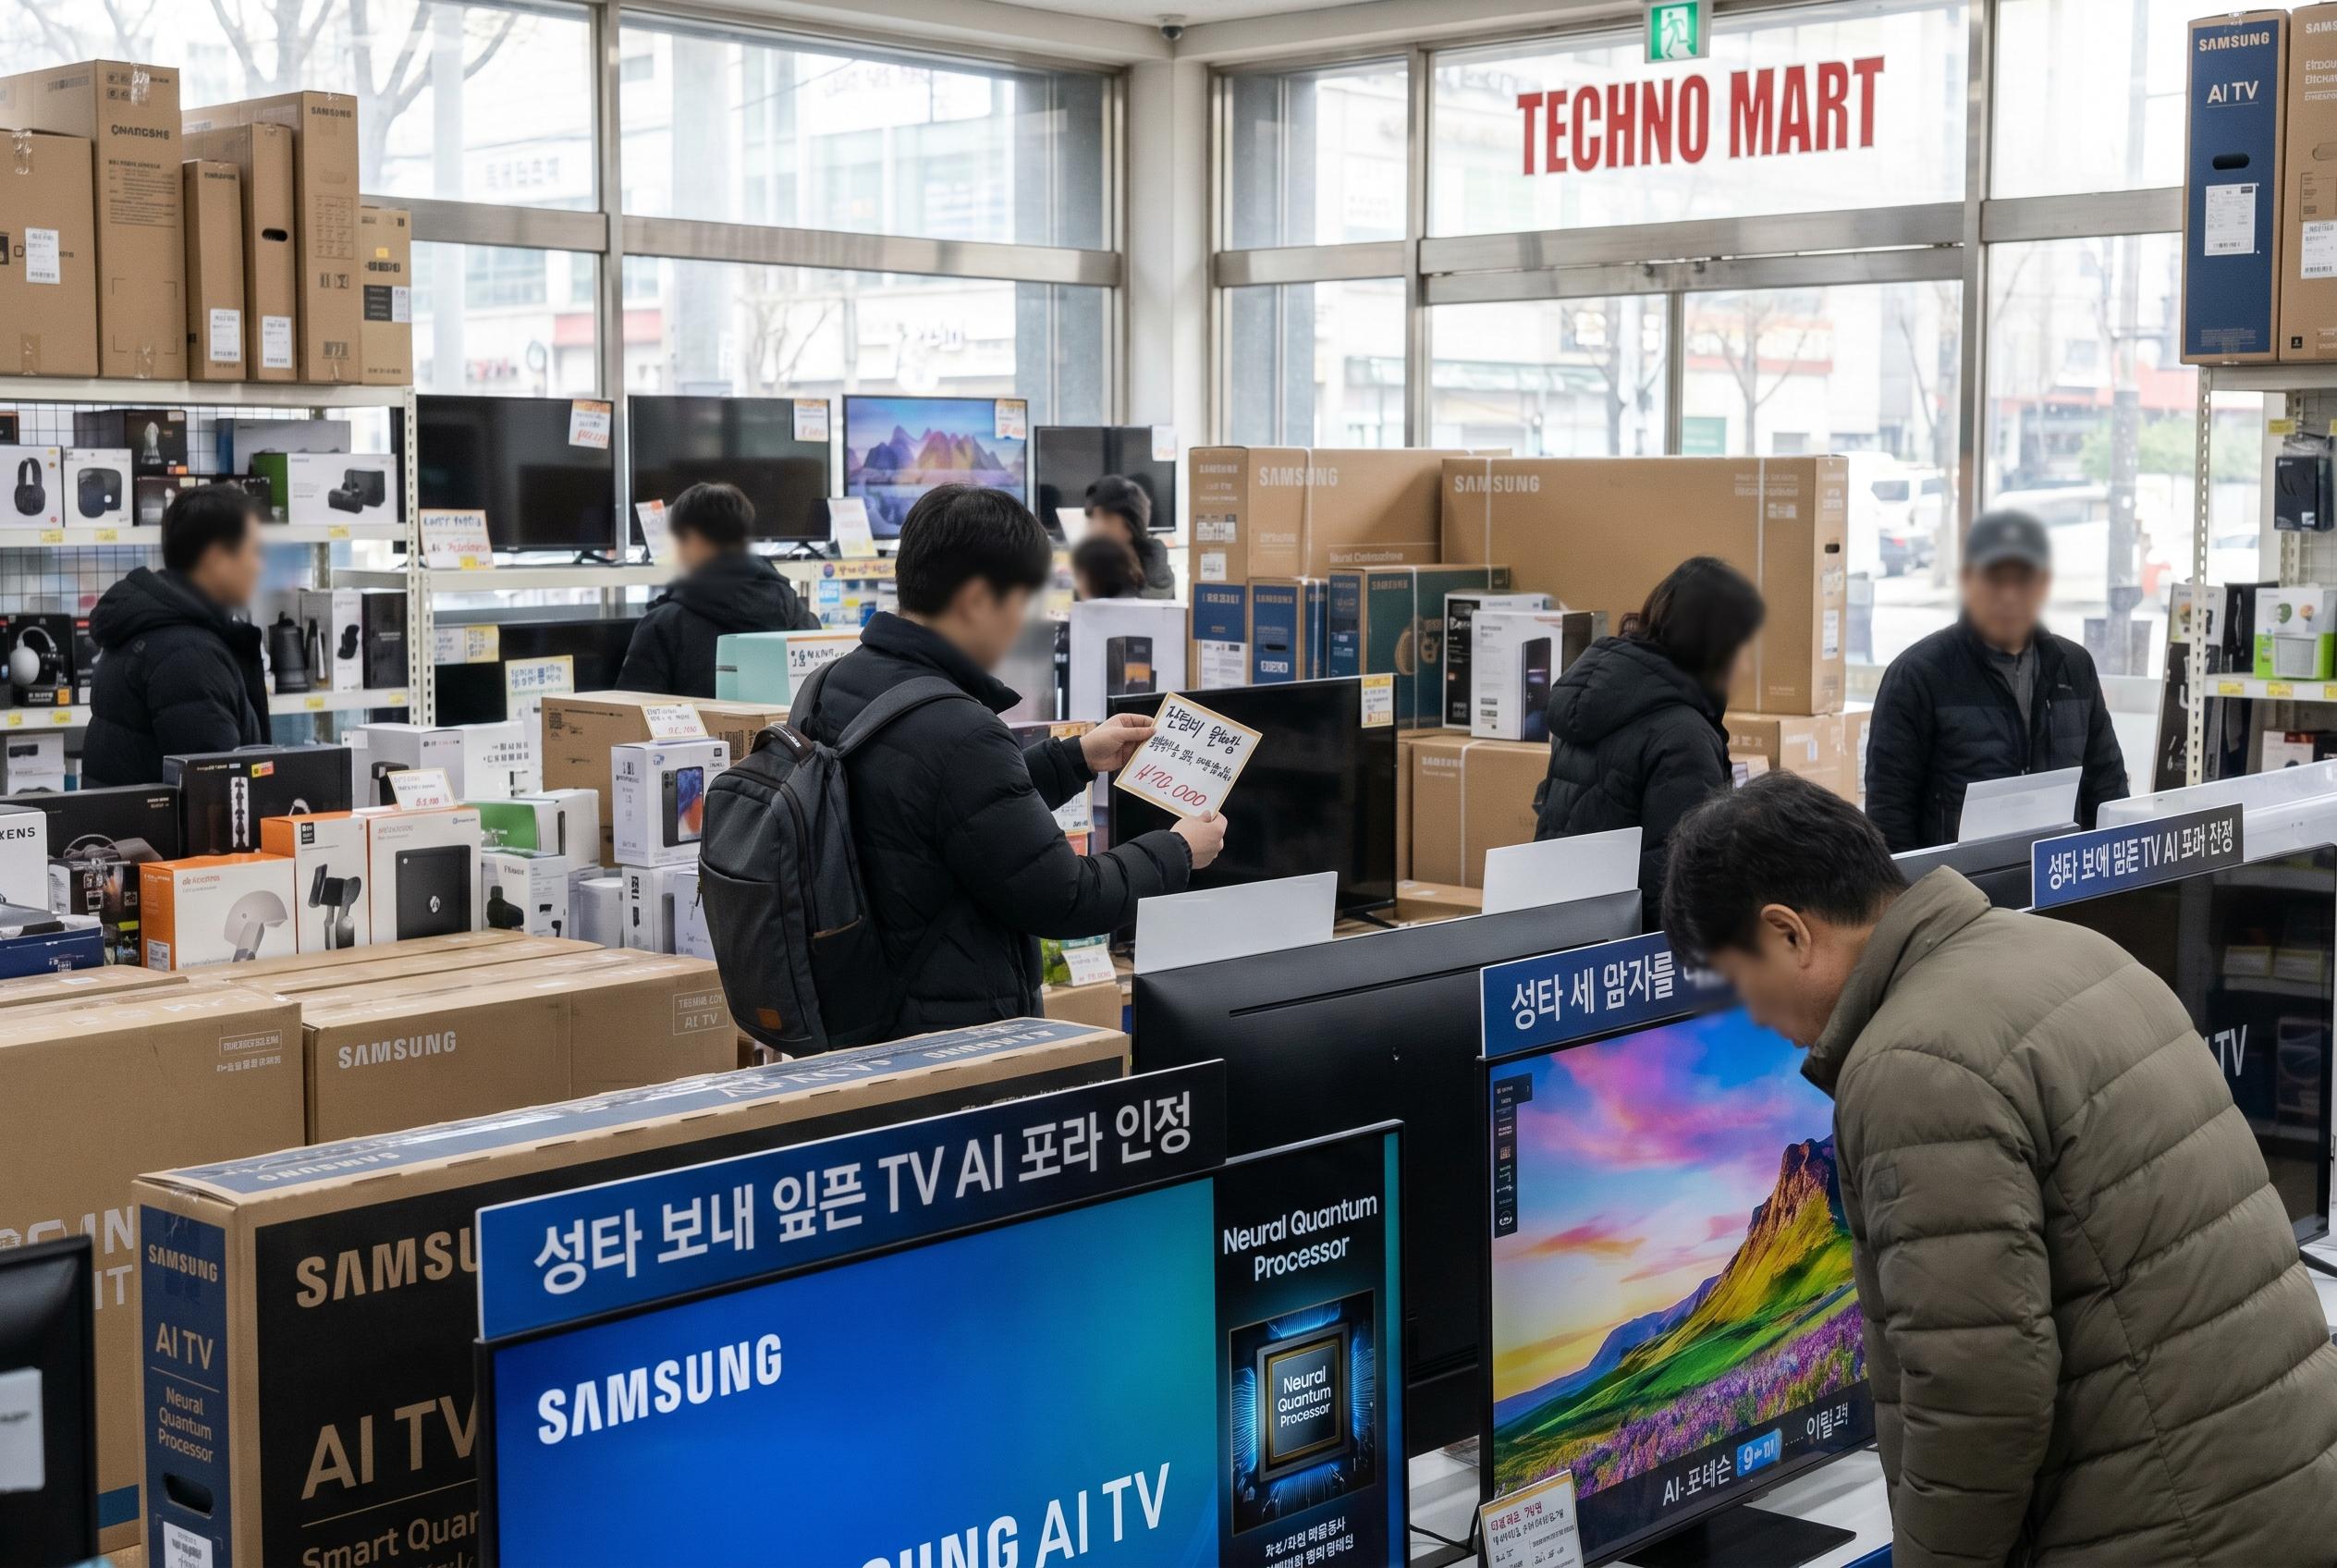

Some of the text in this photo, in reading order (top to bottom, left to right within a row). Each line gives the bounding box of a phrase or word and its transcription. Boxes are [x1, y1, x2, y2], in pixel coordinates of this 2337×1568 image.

[2199, 31, 2270, 52] SAMSUNG
[2207, 80, 2259, 104] AI TV
[1517, 55, 1886, 177] TECHNO MART
[1259, 466, 1339, 486] SAMSUNG
[1454, 474, 1539, 493] SAMSUNG
[2141, 834, 2161, 868] TV
[2164, 830, 2178, 864] AI
[702, 1012, 718, 1025] TV
[1511, 974, 1564, 1031] 성타
[1571, 967, 1595, 1014] 세
[338, 1030, 457, 1070] SAMSUNG
[2215, 1023, 2247, 1078] TV
[533, 1091, 1192, 1295] 성타 보내 잎픈 TV AI 포라 인정
[1223, 1194, 1378, 1256] Neural Quantum
[148, 1243, 218, 1283] SAMSUNG
[1254, 1235, 1351, 1282] Processor
[155, 1322, 214, 1370] AI TV
[537, 1332, 783, 1446] SAMSUNG
[1283, 1365, 1327, 1393] Neural
[165, 1386, 203, 1416] Neural
[1278, 1387, 1332, 1414] Quantum
[1280, 1401, 1331, 1428] Processor
[159, 1406, 213, 1441] Quantum
[159, 1427, 214, 1464] Processor
[301, 1394, 478, 1501] AI TV
[1034, 1489, 1089, 1568] AI
[1102, 1462, 1170, 1543] TV
[302, 1527, 399, 1568] Smart
